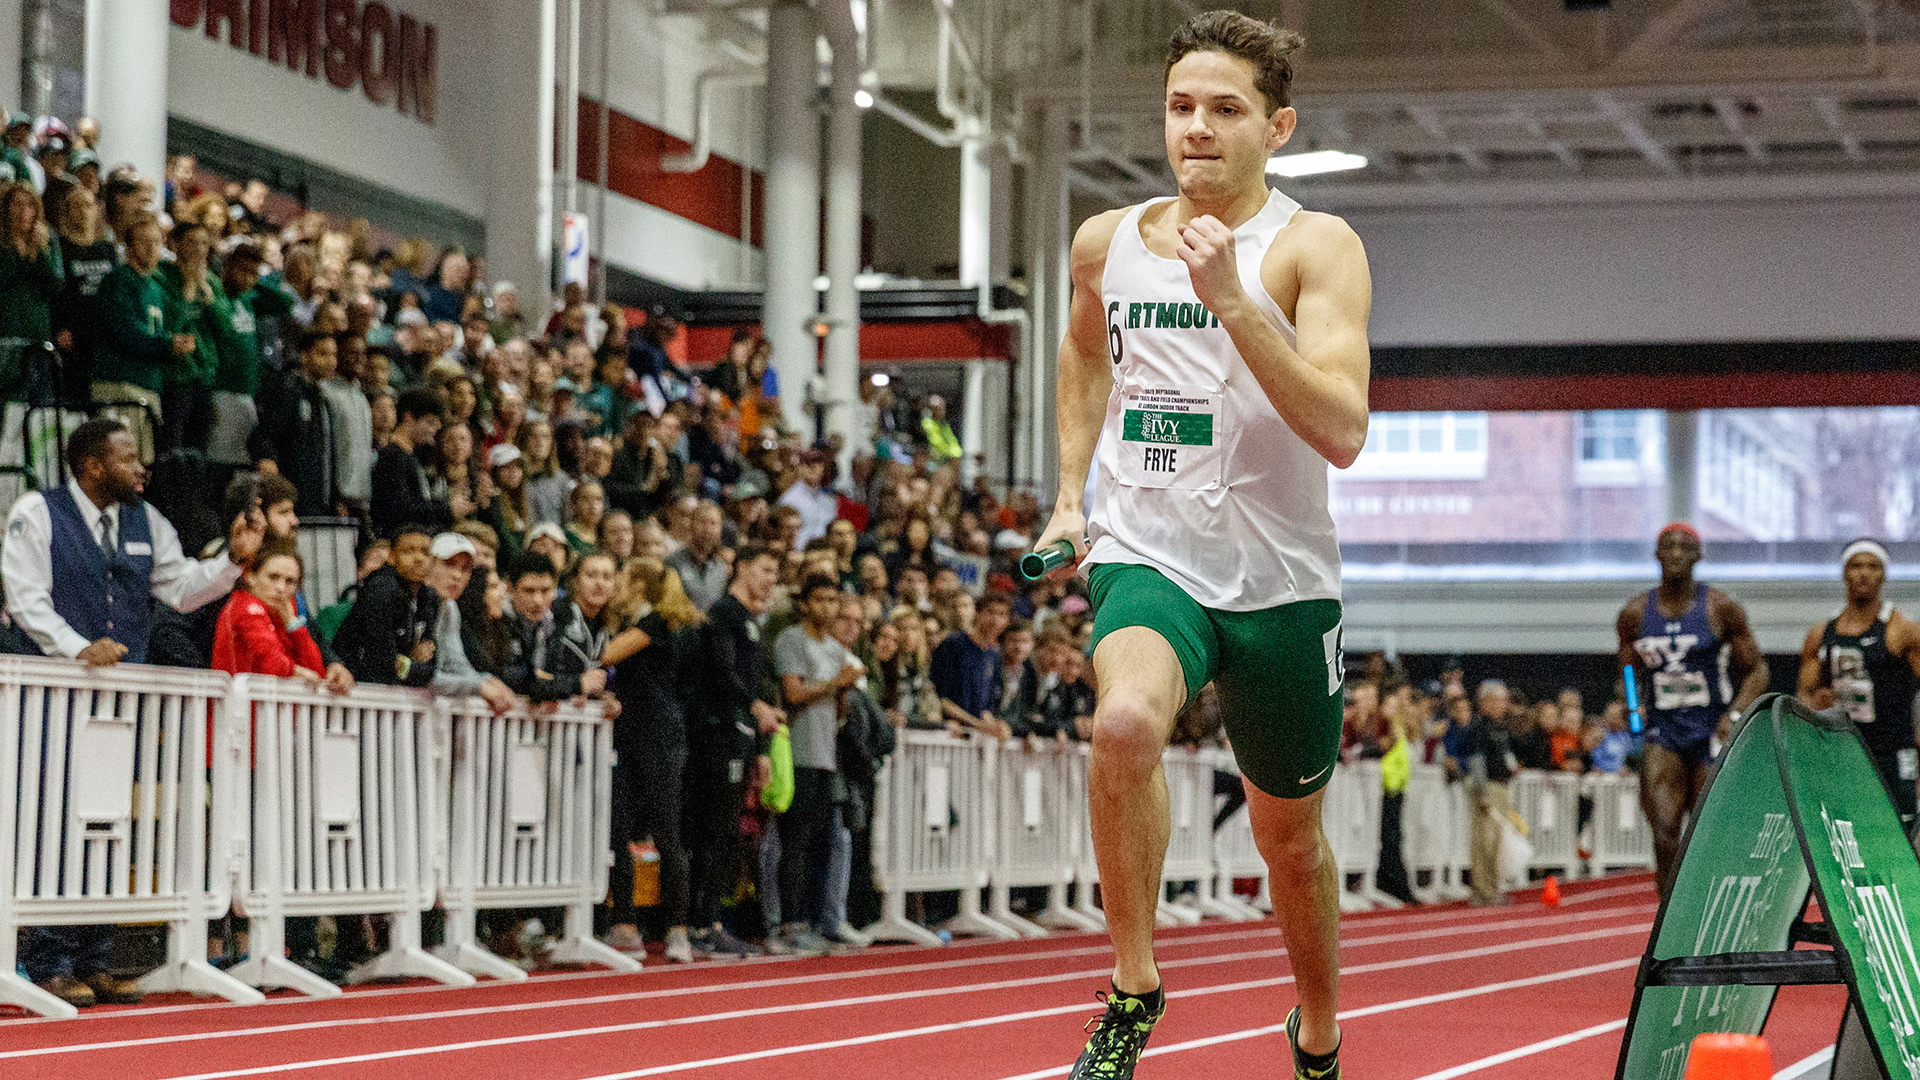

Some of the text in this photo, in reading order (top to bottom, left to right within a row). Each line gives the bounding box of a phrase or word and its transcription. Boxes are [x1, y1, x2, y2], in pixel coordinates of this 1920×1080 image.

[169, 0, 436, 124] IMSON
[1124, 303, 1219, 329] RTMOU
[1108, 301, 1123, 365] 6
[1171, 397, 1210, 405] CHAMPIONSHIPS
[1151, 419, 1180, 435] IVY
[1144, 447, 1177, 473] FRYE
